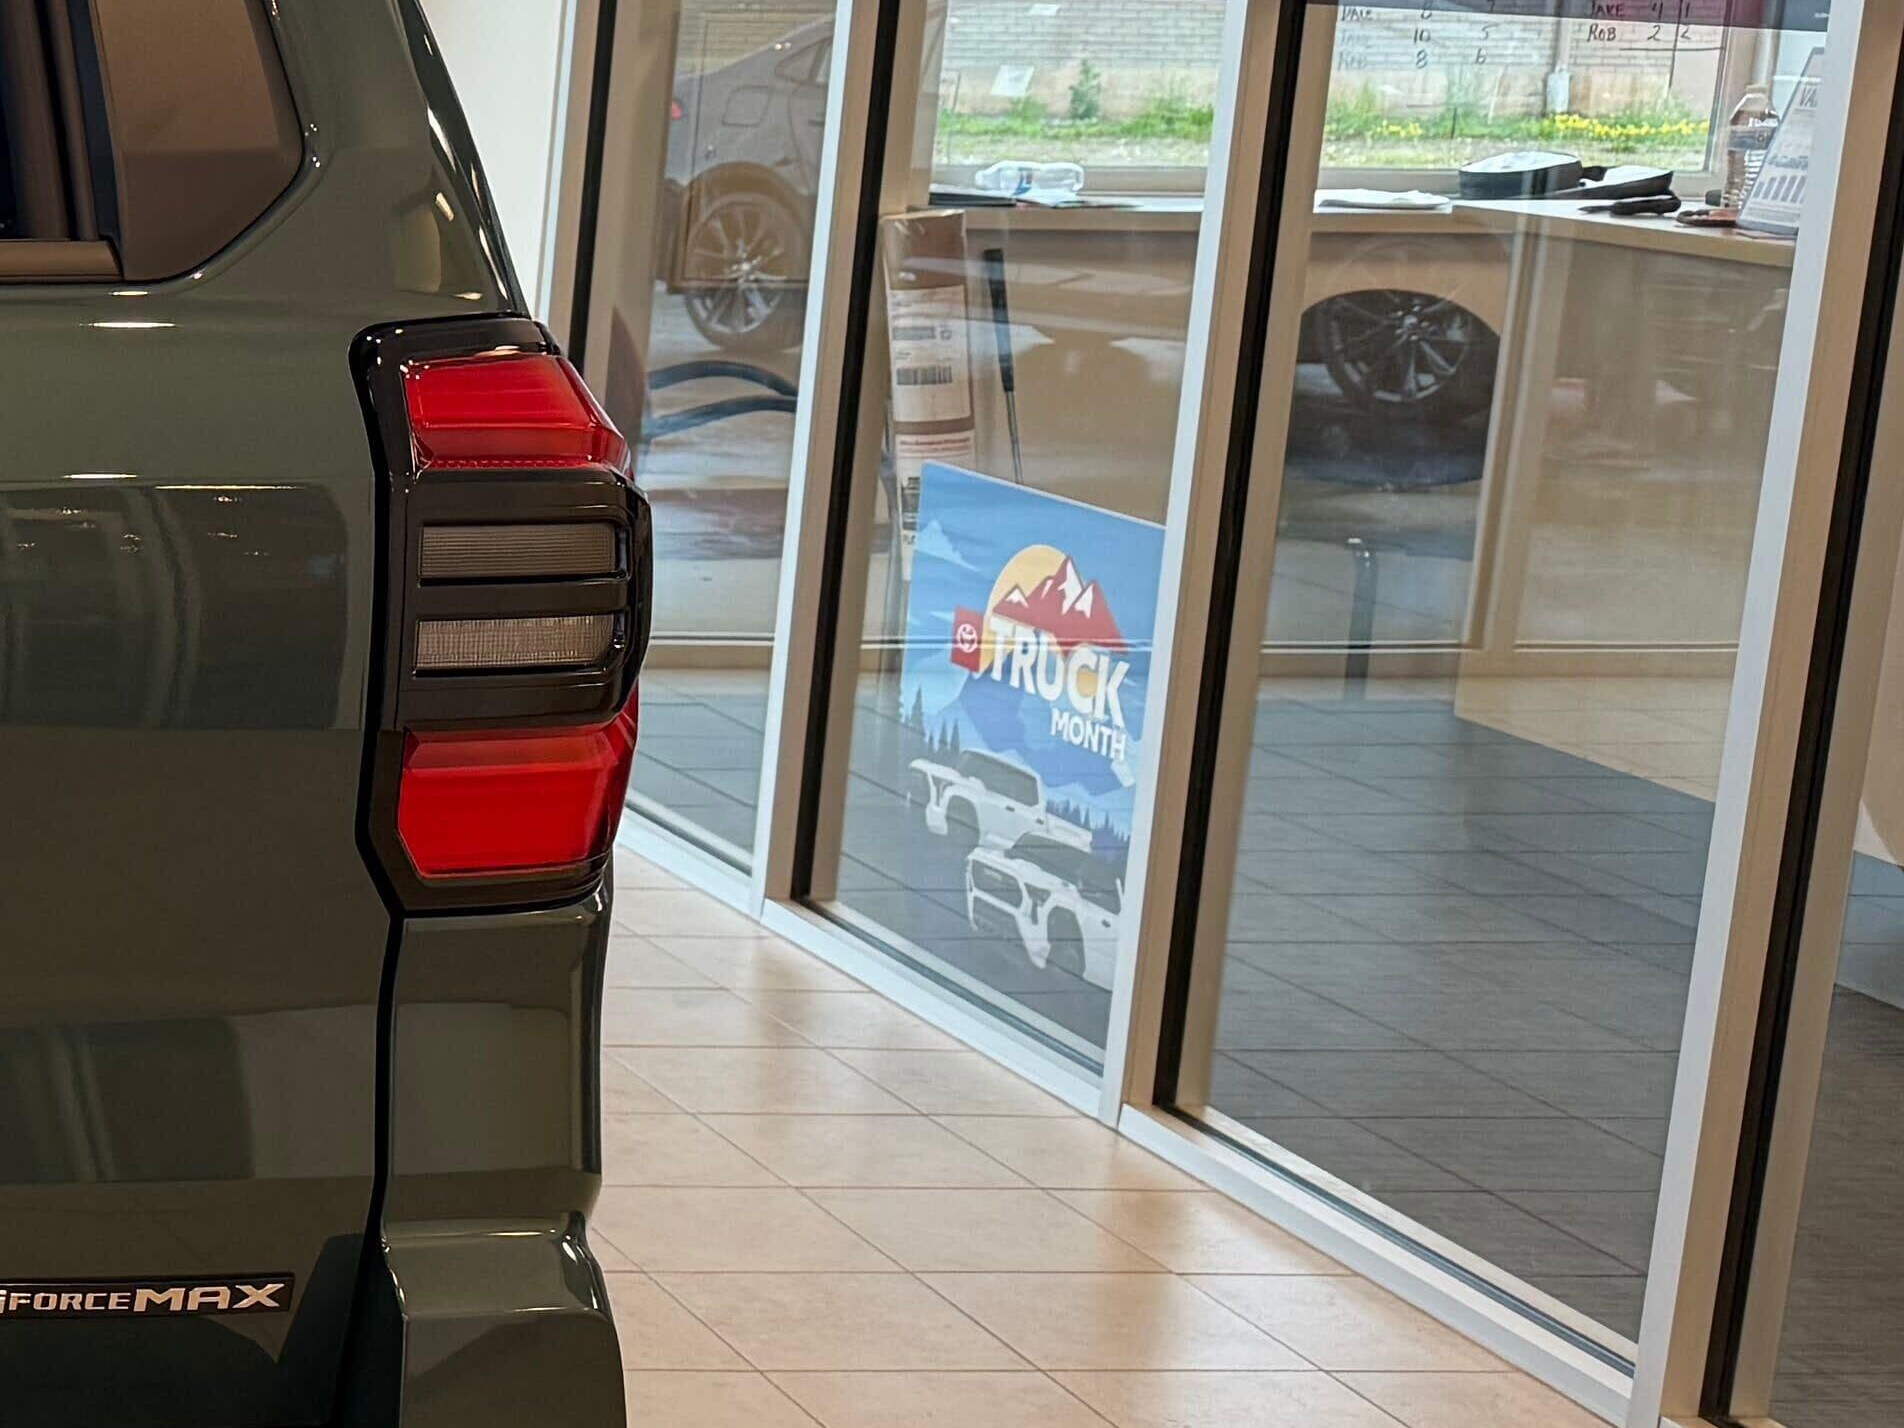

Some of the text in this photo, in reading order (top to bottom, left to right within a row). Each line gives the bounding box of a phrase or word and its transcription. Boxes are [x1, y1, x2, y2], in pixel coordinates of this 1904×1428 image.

[1413, 27, 1432, 45] 10
[1587, 23, 1618, 43] ROB
[1647, 24, 1662, 42] 2
[988, 614, 1131, 728] TRUCK
[1049, 707, 1127, 762] MONTH
